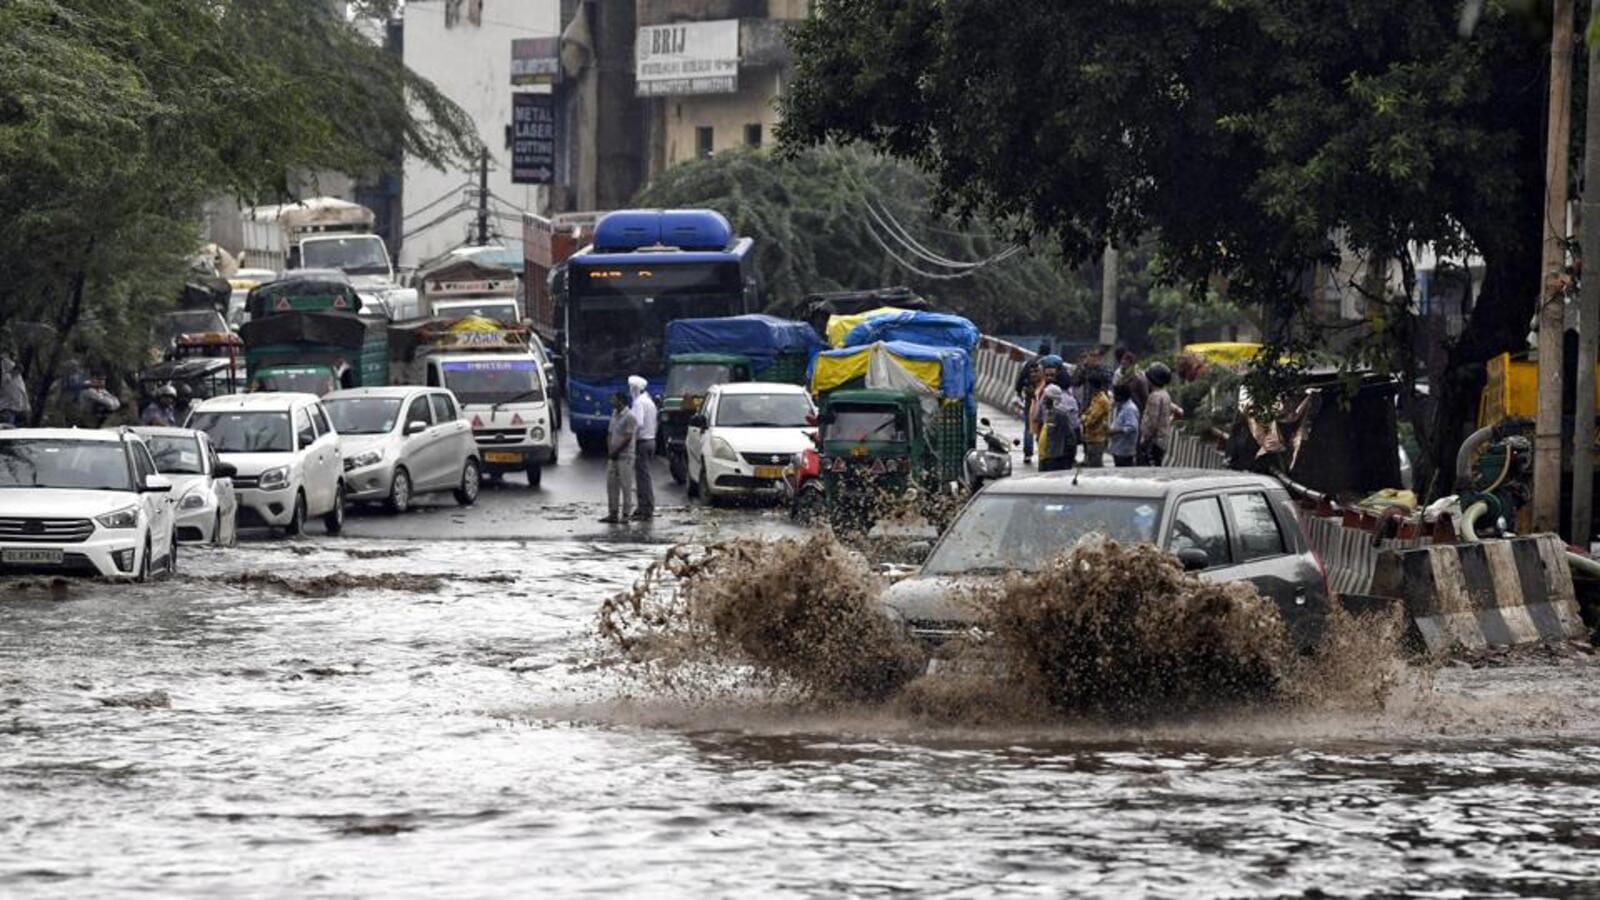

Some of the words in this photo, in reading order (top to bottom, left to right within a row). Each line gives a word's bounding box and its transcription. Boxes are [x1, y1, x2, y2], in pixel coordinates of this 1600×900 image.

[652, 26, 686, 54] BRIJ
[515, 106, 553, 121] METAL
[515, 122, 553, 138] LASER
